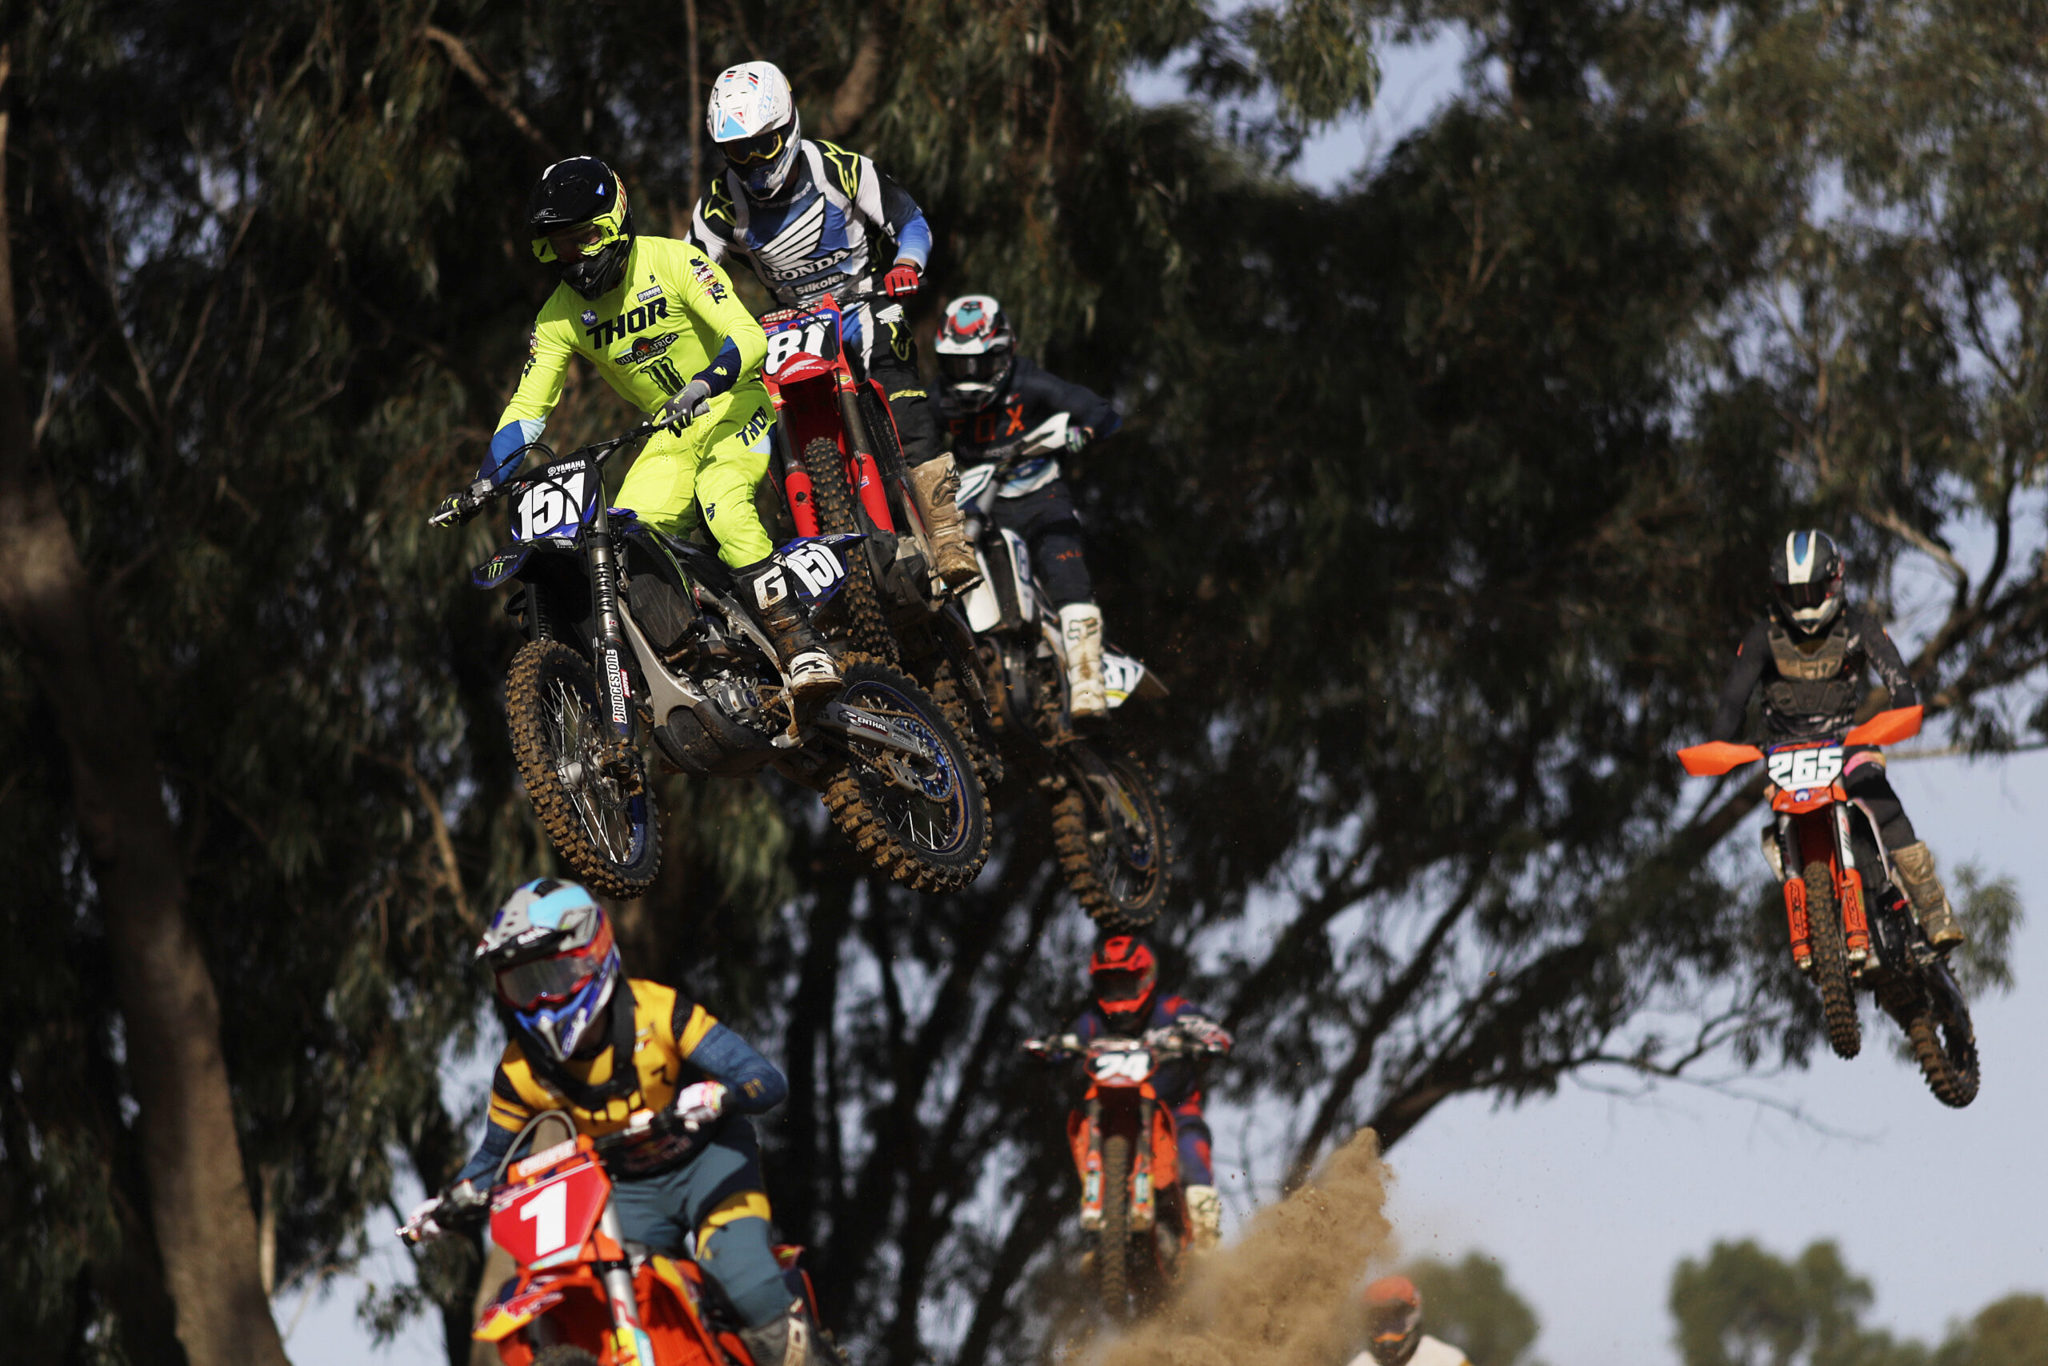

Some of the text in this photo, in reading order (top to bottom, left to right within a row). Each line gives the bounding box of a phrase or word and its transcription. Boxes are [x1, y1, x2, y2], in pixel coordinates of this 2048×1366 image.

[765, 250, 851, 281] HONDA
[586, 296, 670, 350] THOR
[765, 322, 825, 375] 81
[949, 404, 1024, 443] FOX
[556, 460, 586, 473] YAMAHA
[518, 472, 585, 540] 151
[594, 562, 614, 616] YAMAHA
[785, 543, 845, 598] 151
[605, 649, 627, 725] BRIDGESTONE
[1768, 747, 1843, 784] 265
[520, 1180, 567, 1257] 1
